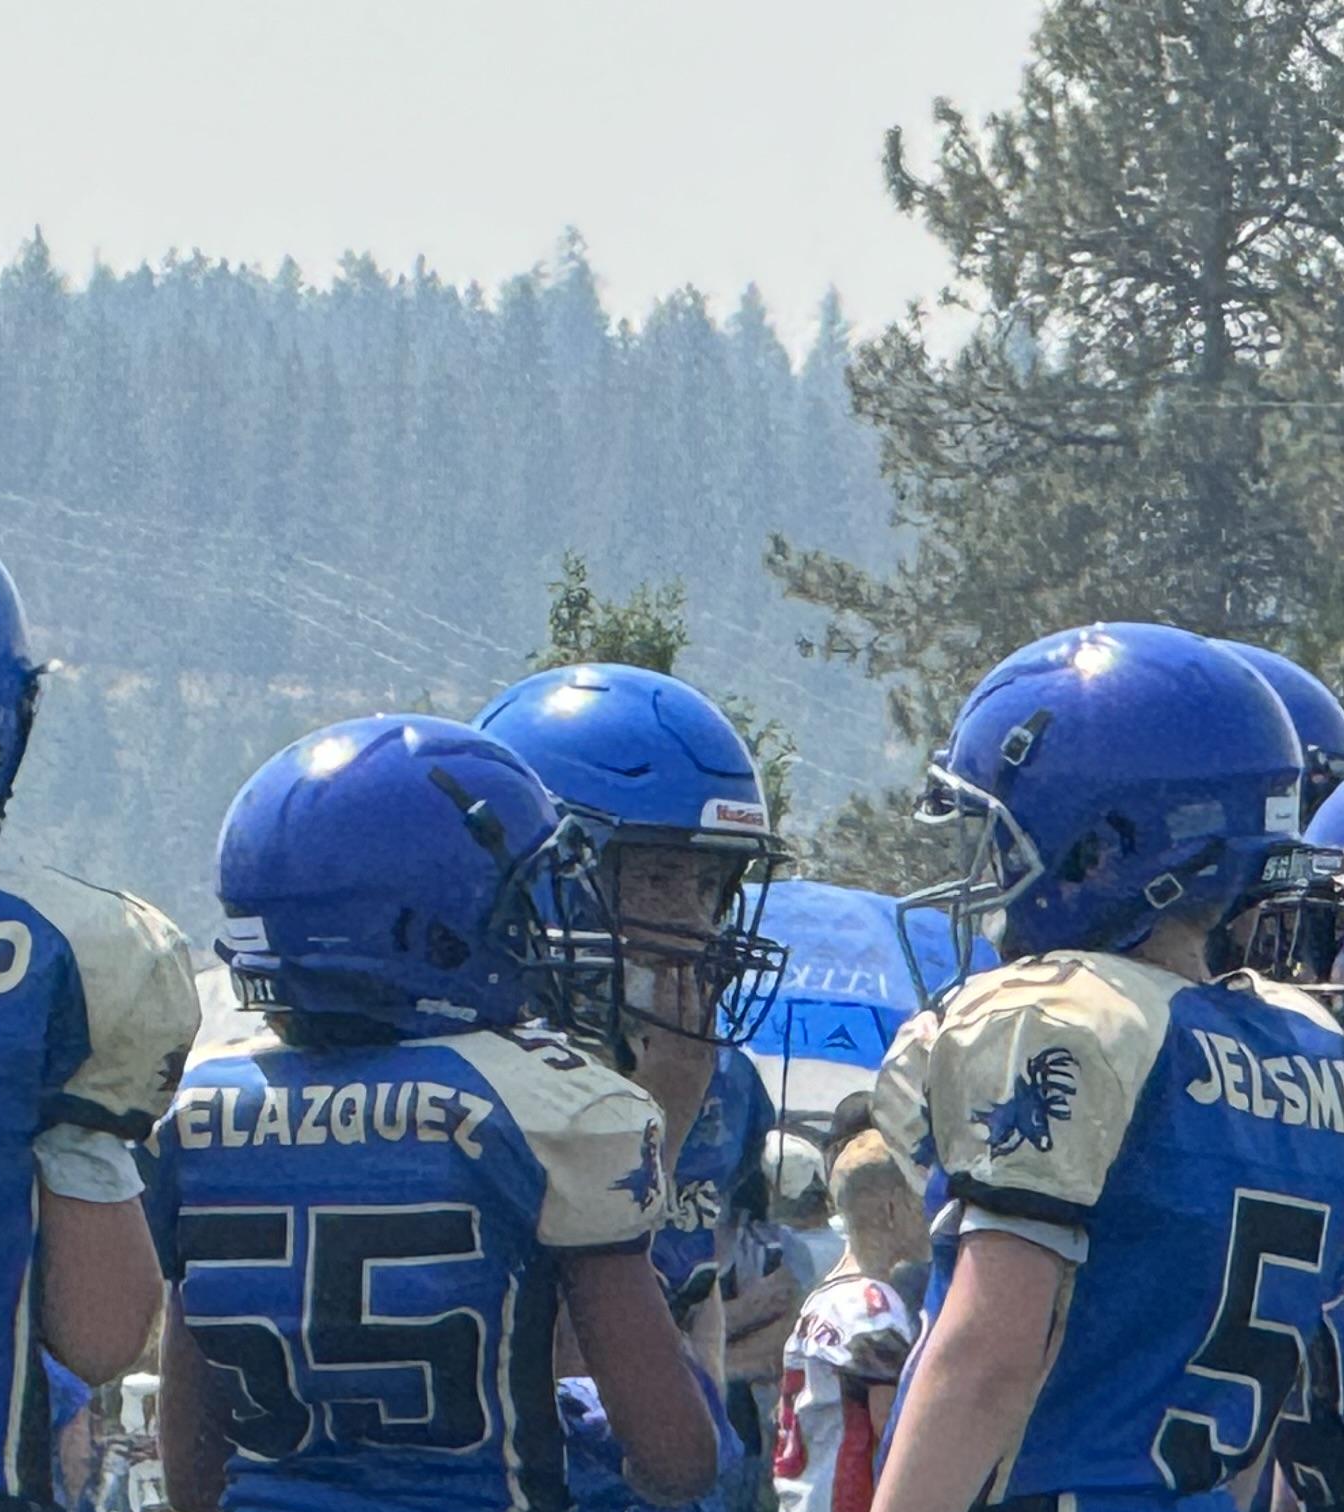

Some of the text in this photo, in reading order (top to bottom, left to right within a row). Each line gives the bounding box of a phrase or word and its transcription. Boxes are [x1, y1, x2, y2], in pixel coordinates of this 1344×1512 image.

[141, 1082, 496, 1161] ELAZQUEZ
[177, 1200, 493, 1463] 55
[1150, 1187, 1331, 1492] 5
